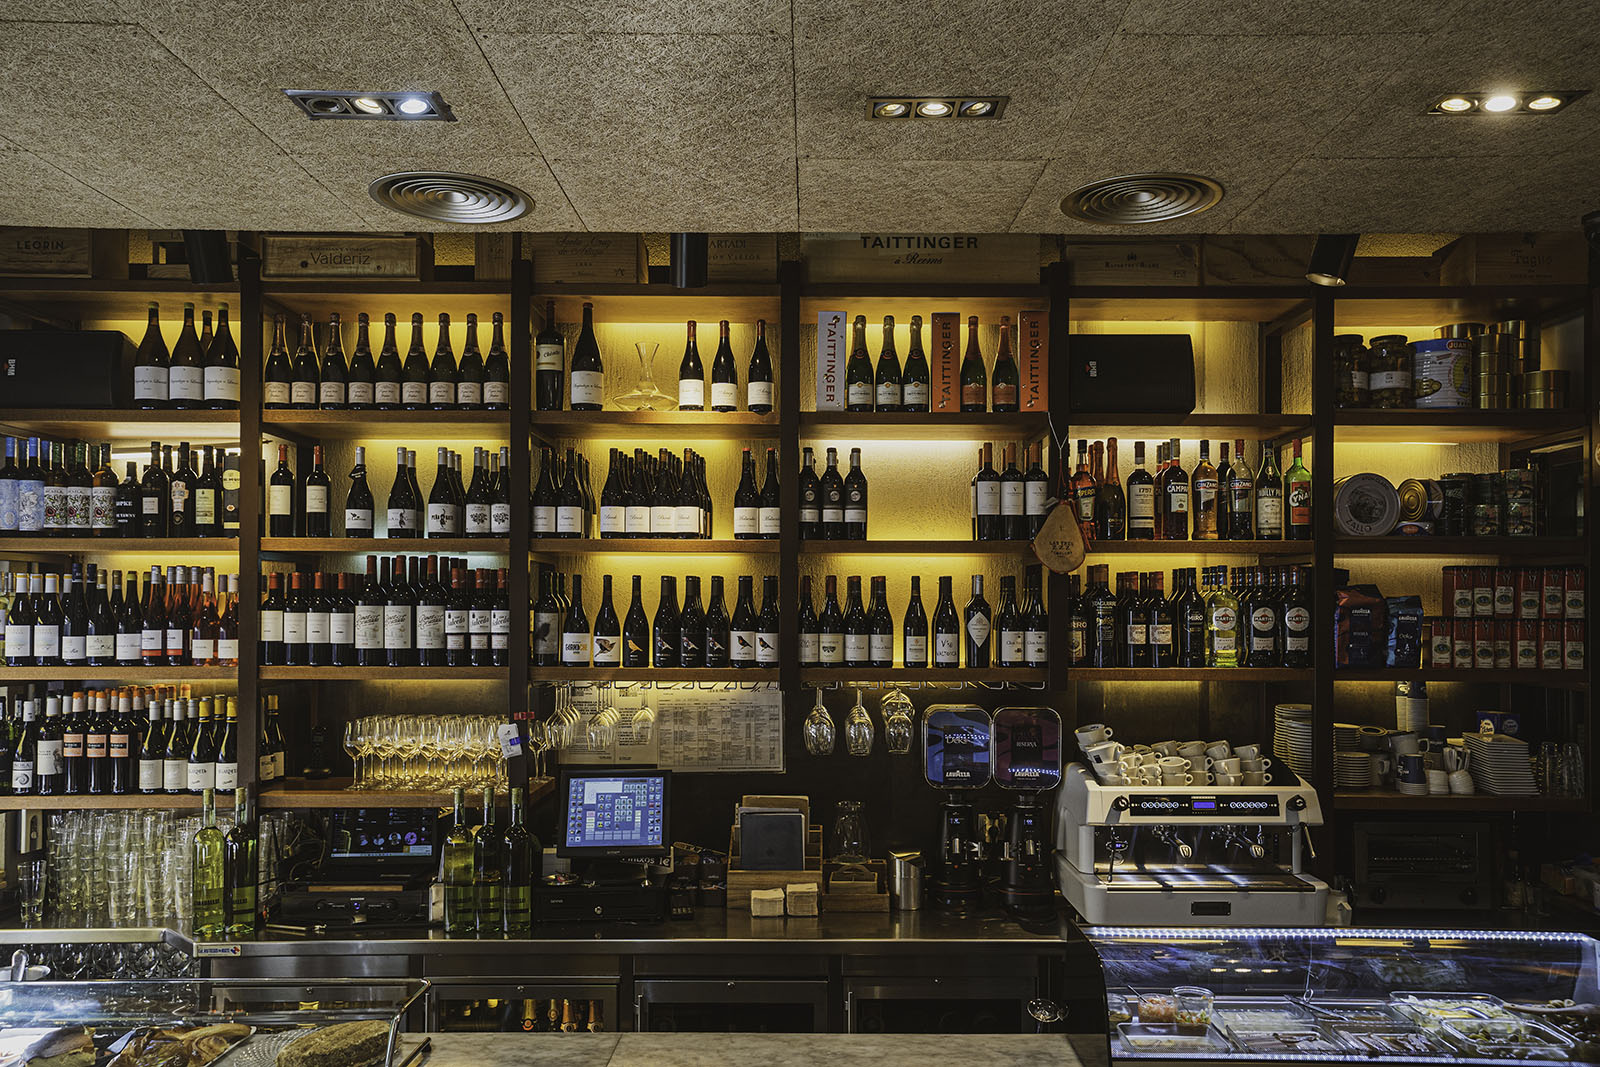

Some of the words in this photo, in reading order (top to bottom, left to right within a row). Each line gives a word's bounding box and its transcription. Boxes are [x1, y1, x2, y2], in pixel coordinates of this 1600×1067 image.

[861, 236, 979, 249] TAITTINGER
[310, 252, 370, 265] Valderiz
[903, 253, 943, 265] Reims
[826, 321, 837, 402] TAITTINGER
[941, 321, 952, 401] TAITTINGER
[1029, 320, 1040, 402] TAITTINGER
[1289, 490, 1309, 507] CYNA
